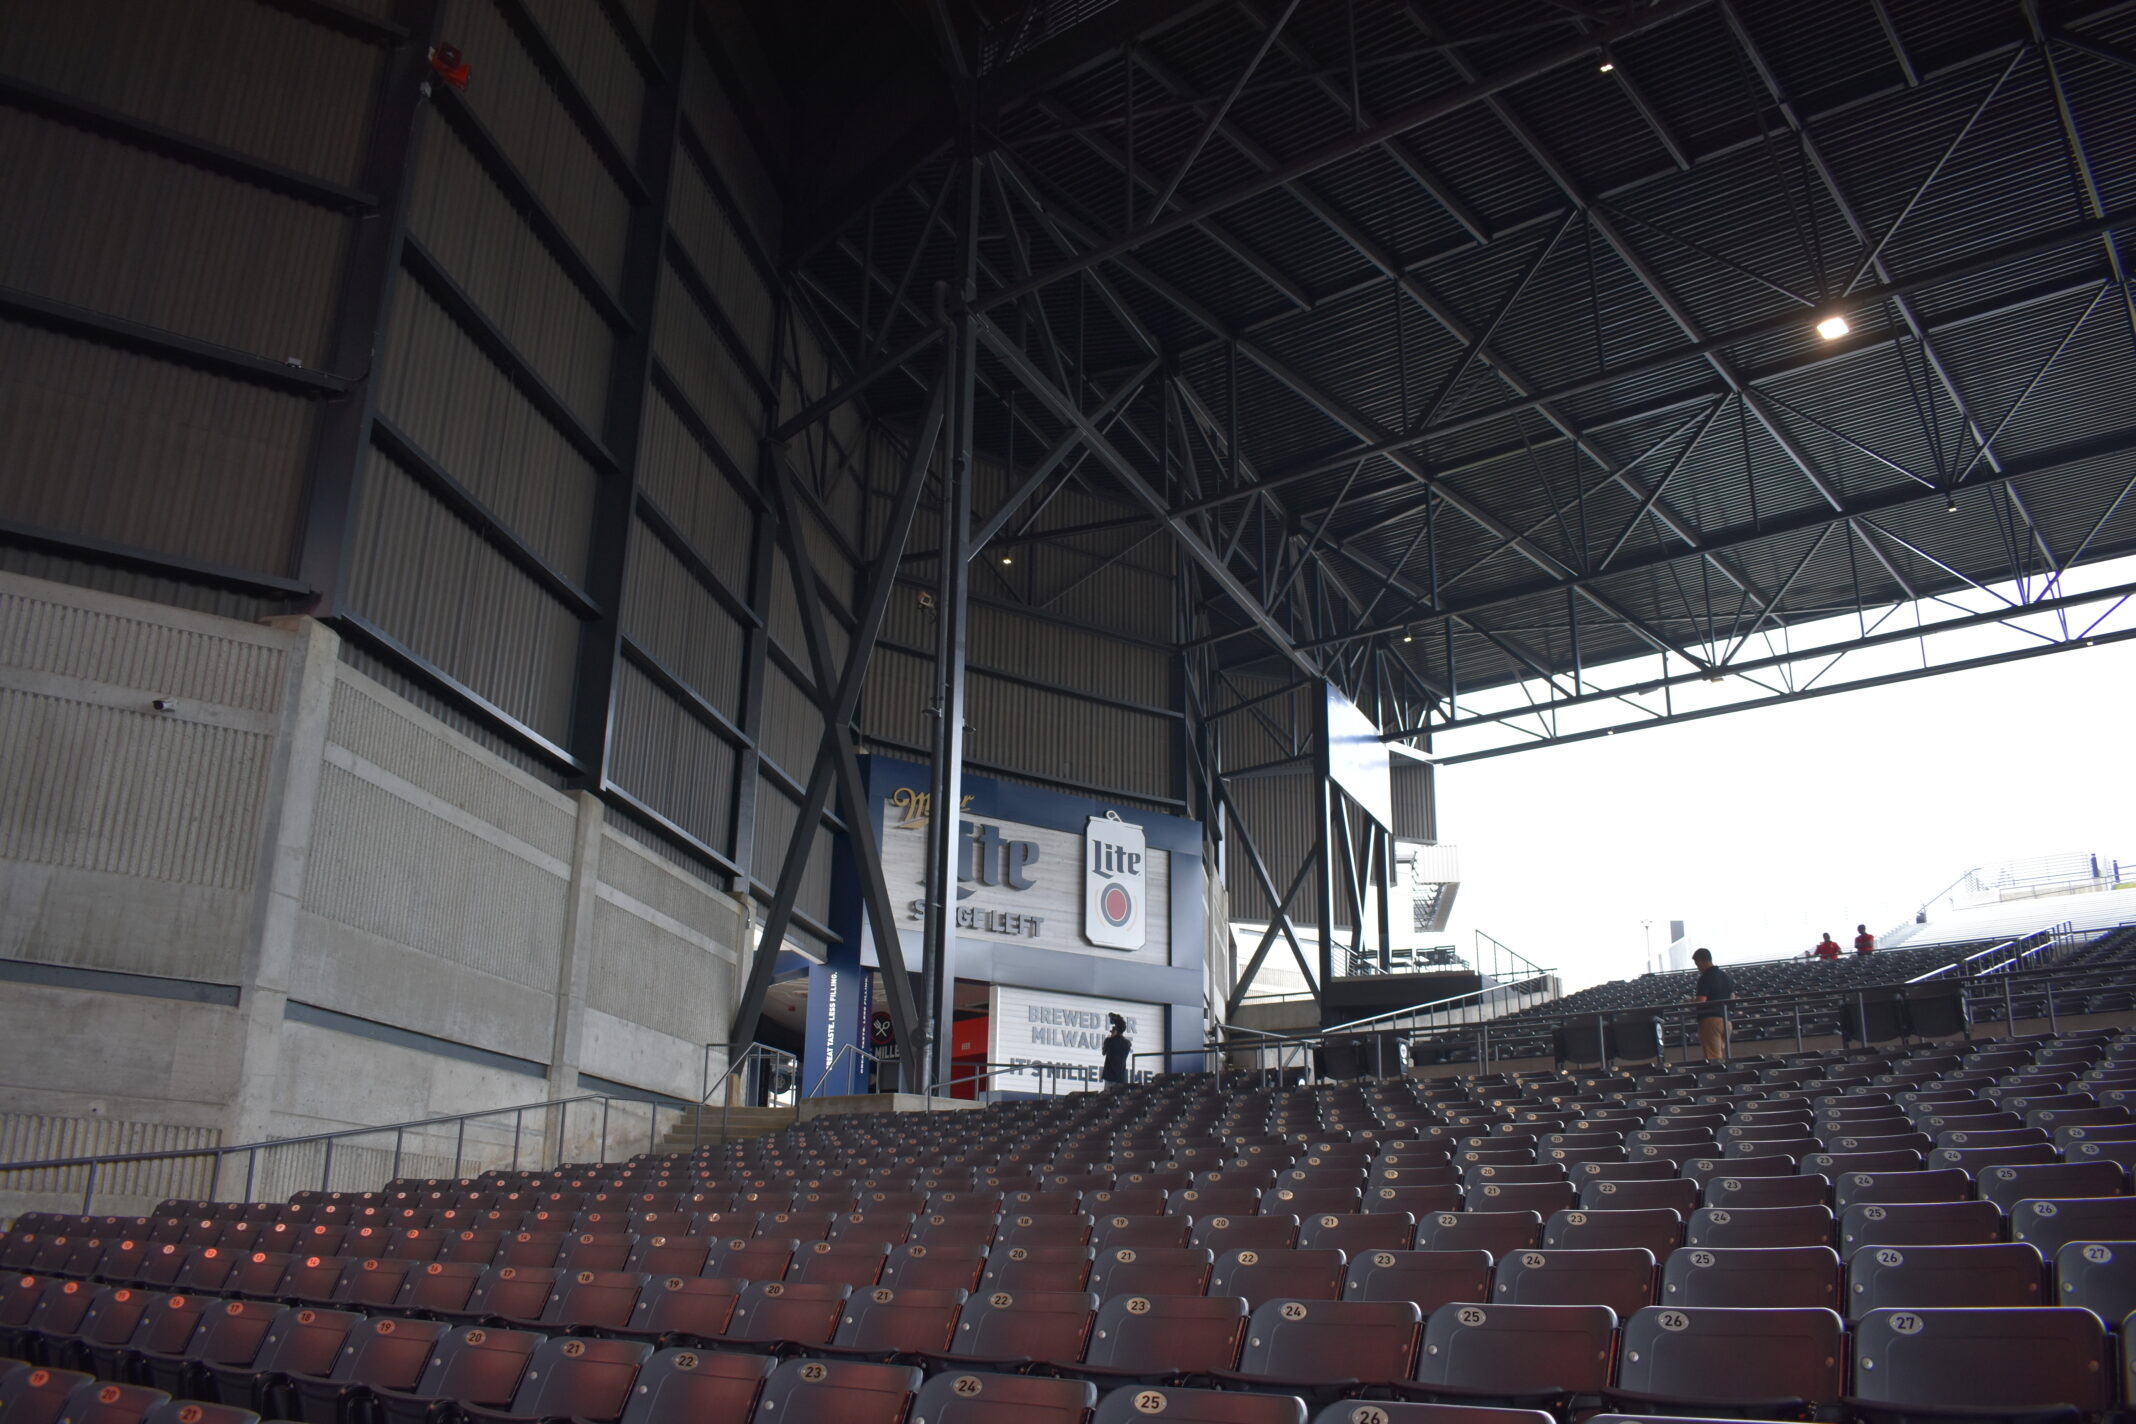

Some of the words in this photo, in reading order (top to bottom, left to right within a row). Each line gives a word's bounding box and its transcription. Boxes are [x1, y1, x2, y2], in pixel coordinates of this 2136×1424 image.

[957, 819, 1040, 900] ite
[1092, 839, 1142, 880] Lite
[912, 899, 986, 929] SGE
[991, 909, 1045, 938] LEFT
[828, 1003, 836, 1020] LESS
[1028, 1005, 1100, 1030] BREWED
[1031, 1026, 1134, 1054] MILWAU
[875, 1044, 900, 1059] MILLE
[1124, 1068, 1154, 1084] IME
[2001, 1170, 2013, 1178] 25
[1869, 1209, 1882, 1217] 25
[2038, 1205, 2053, 1214] 26
[1571, 1215, 1582, 1223] 23
[1714, 1213, 1727, 1221] 24
[1216, 1219, 1226, 1227] 20
[1012, 1250, 1024, 1258] 20
[1121, 1252, 1131, 1260] 21
[1242, 1254, 1254, 1263] 22
[1882, 1252, 1898, 1263] 26
[2089, 1248, 2104, 1259] 27
[1378, 1255, 1390, 1264] 23
[1527, 1256, 1540, 1265] 24
[1695, 1254, 1710, 1264] 25
[582, 1274, 590, 1282] 18
[670, 1280, 679, 1288] 19
[768, 1285, 780, 1294] 20
[877, 1291, 888, 1300] 21
[994, 1296, 1008, 1305] 22
[172, 1298, 180, 1306] 16
[1131, 1301, 1145, 1311] 23
[230, 1304, 243, 1315] 17
[1286, 1306, 1301, 1316] 24
[301, 1313, 311, 1322] 18
[1464, 1311, 1480, 1322] 25
[1665, 1315, 1682, 1327] 26
[381, 1322, 392, 1331] 19
[1896, 1317, 1915, 1329] 27
[469, 1332, 482, 1342] 20
[567, 1343, 580, 1354] 21
[678, 1356, 694, 1367] 22
[805, 1366, 822, 1379] 23
[958, 1380, 976, 1393] 24
[101, 1389, 116, 1400] 20
[1141, 1395, 1160, 1409] 25
[182, 1408, 197, 1420] 21
[1360, 1411, 1380, 1424] 26
